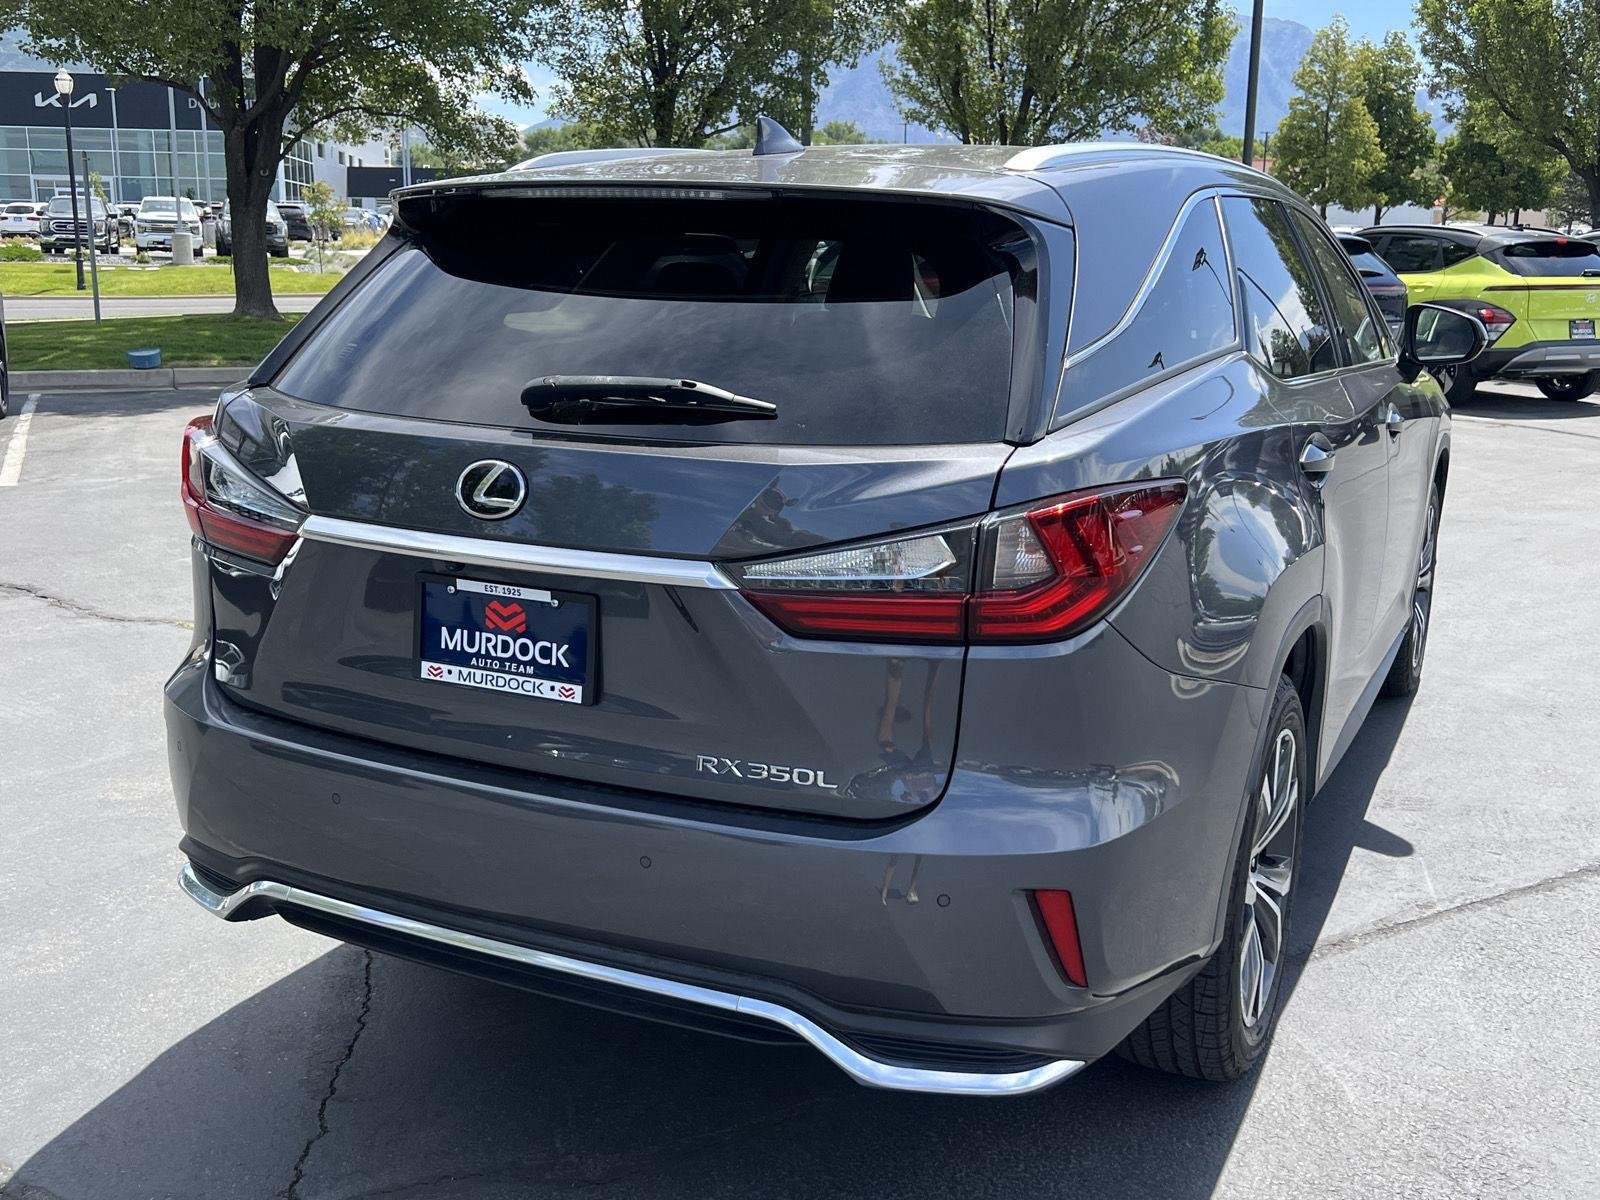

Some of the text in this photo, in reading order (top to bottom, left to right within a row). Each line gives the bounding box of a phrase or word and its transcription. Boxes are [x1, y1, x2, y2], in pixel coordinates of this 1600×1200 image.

[484, 585, 522, 597] EST. 1925
[441, 626, 570, 668] MURDOCK
[470, 657, 534, 675] AUTO TEAM
[457, 669, 544, 695] MURDOCK
[696, 754, 838, 789] RX 350L
